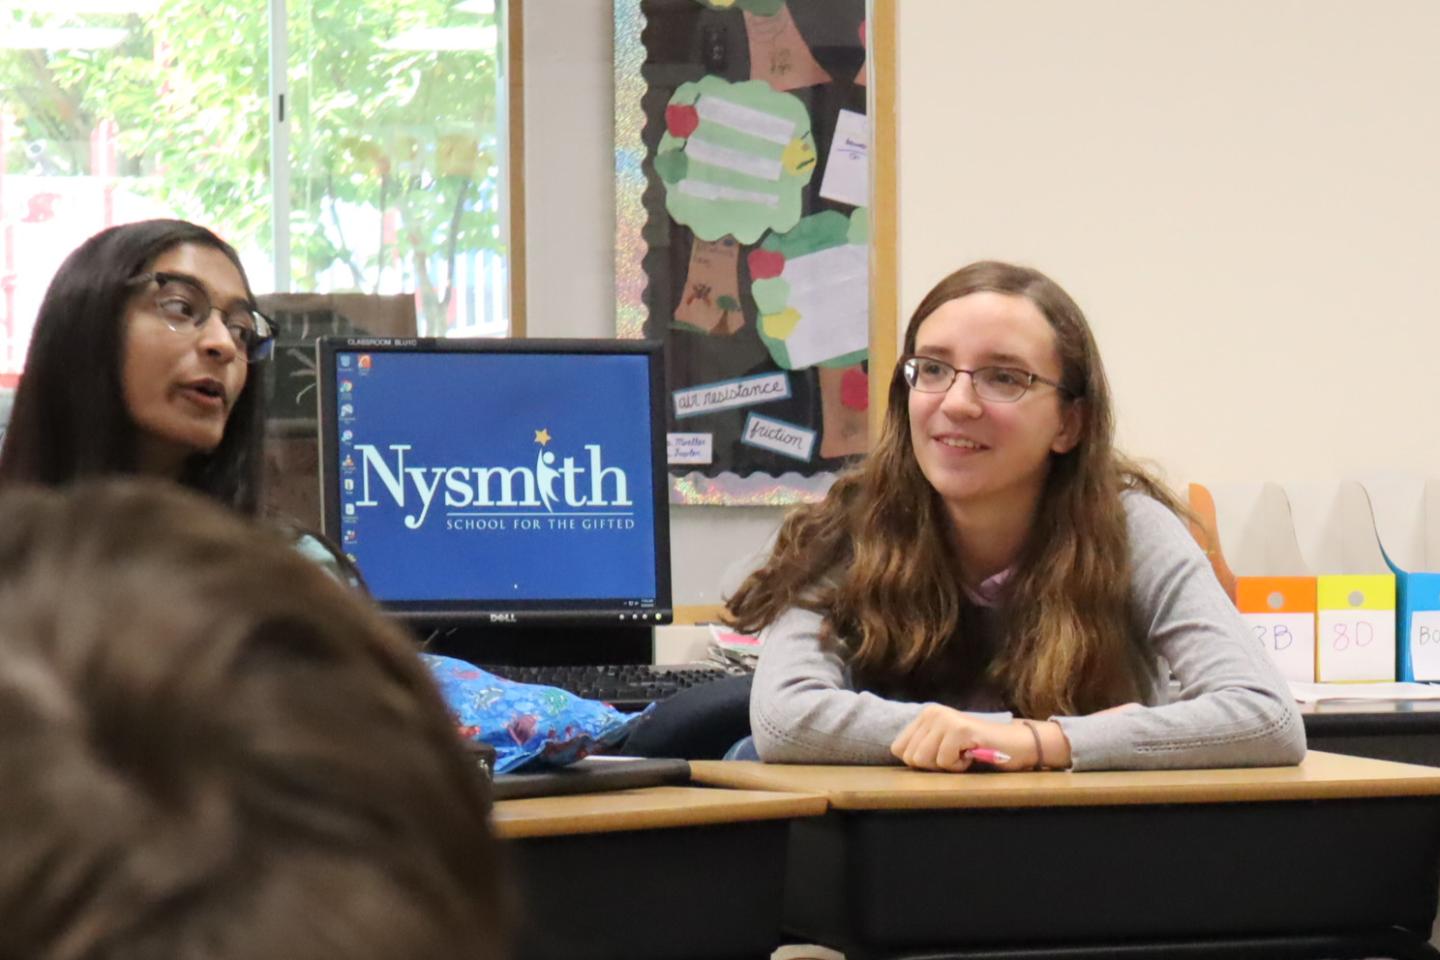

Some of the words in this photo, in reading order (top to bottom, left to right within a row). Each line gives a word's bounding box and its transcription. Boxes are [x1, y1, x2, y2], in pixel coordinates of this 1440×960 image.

[678, 392, 700, 408] air
[703, 381, 785, 406] resistance
[750, 420, 803, 449] friction
[353, 443, 633, 530] Nysmith
[446, 519, 507, 530] SCHOOL
[513, 519, 542, 530] FOR
[547, 519, 576, 530] THE
[582, 518, 635, 530] GIFTED
[489, 613, 518, 623] DELL
[1333, 620, 1374, 651] 8D
